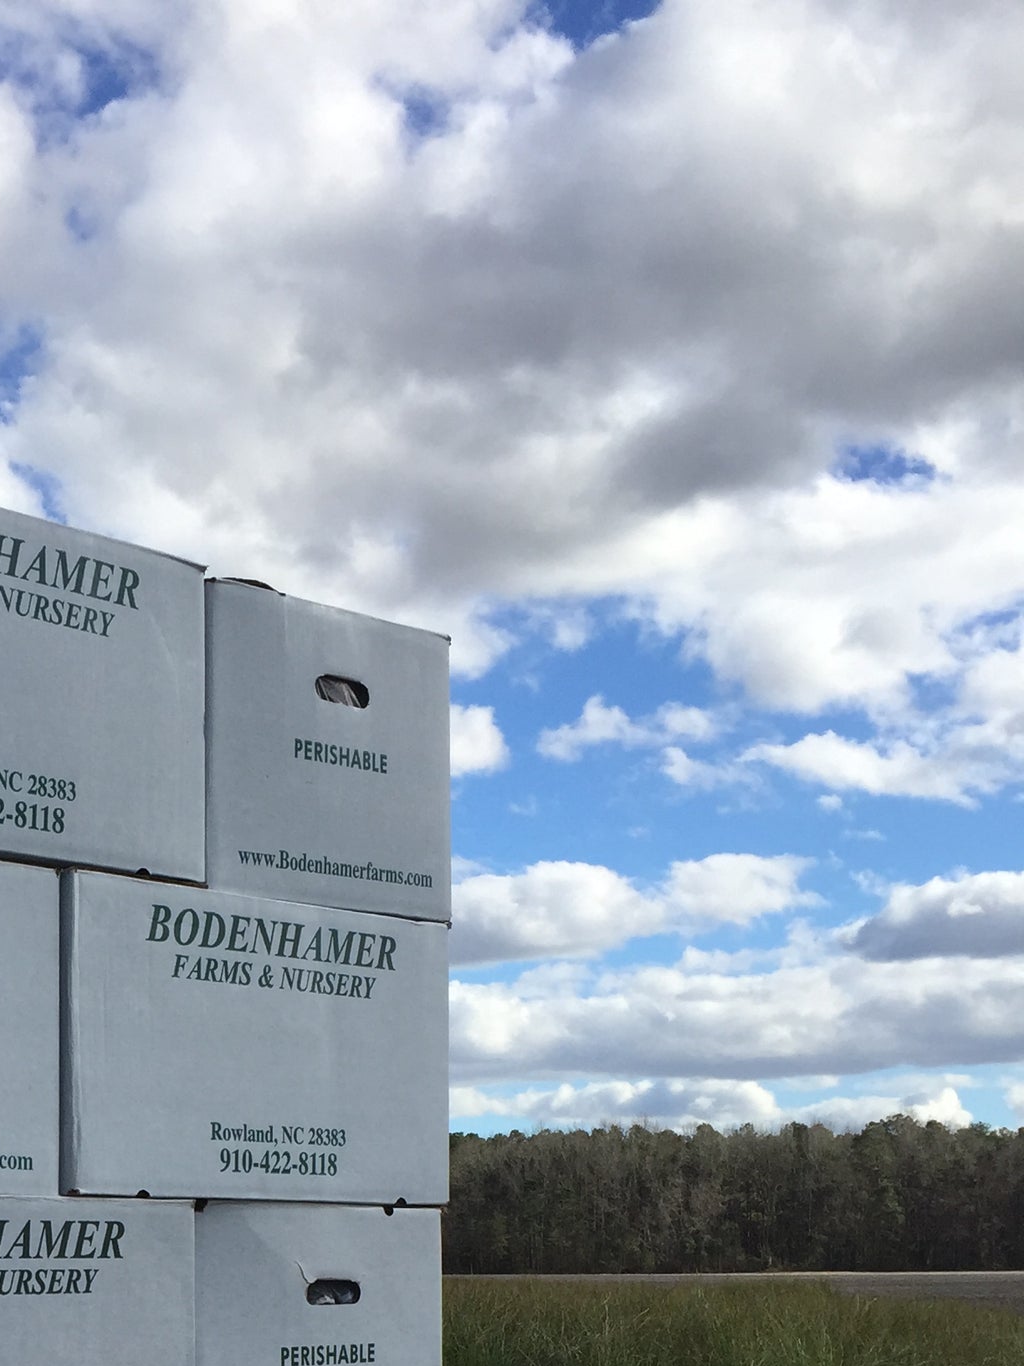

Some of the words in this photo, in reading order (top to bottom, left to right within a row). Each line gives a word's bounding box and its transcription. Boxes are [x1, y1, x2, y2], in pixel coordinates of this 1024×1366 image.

[295, 738, 387, 774] PERISHABLE
[27, 775, 76, 801] 28383
[238, 851, 432, 888] www.Bodenhamerfarms.com
[145, 904, 396, 971] BODENHAMER
[172, 954, 253, 985] FARMS
[258, 965, 274, 988] &
[279, 967, 376, 999] NURSERY
[210, 1122, 278, 1147] Rowland,
[282, 1126, 304, 1145] NC
[308, 1128, 346, 1147] 28383
[220, 1148, 337, 1176] 910-422-8118
[281, 1343, 375, 1366] PERISHABLE
